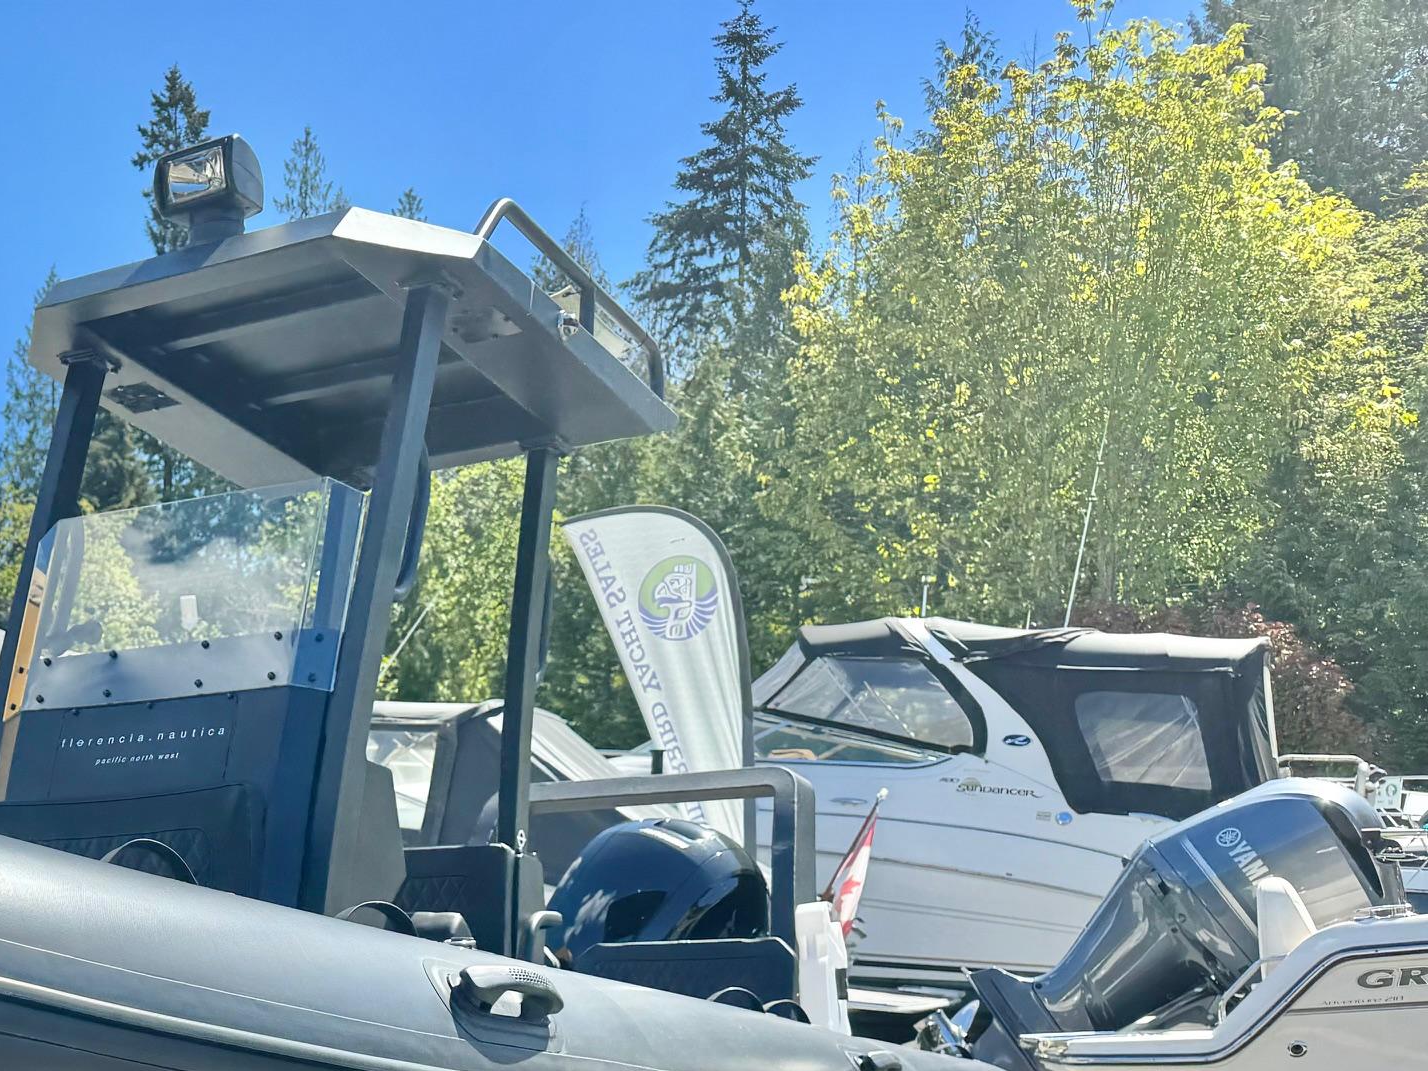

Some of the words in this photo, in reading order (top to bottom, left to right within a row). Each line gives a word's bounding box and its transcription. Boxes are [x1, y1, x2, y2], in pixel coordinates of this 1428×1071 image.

[94, 754, 127, 766] pacific
[130, 753, 154, 763] north
[158, 751, 180, 761] west
